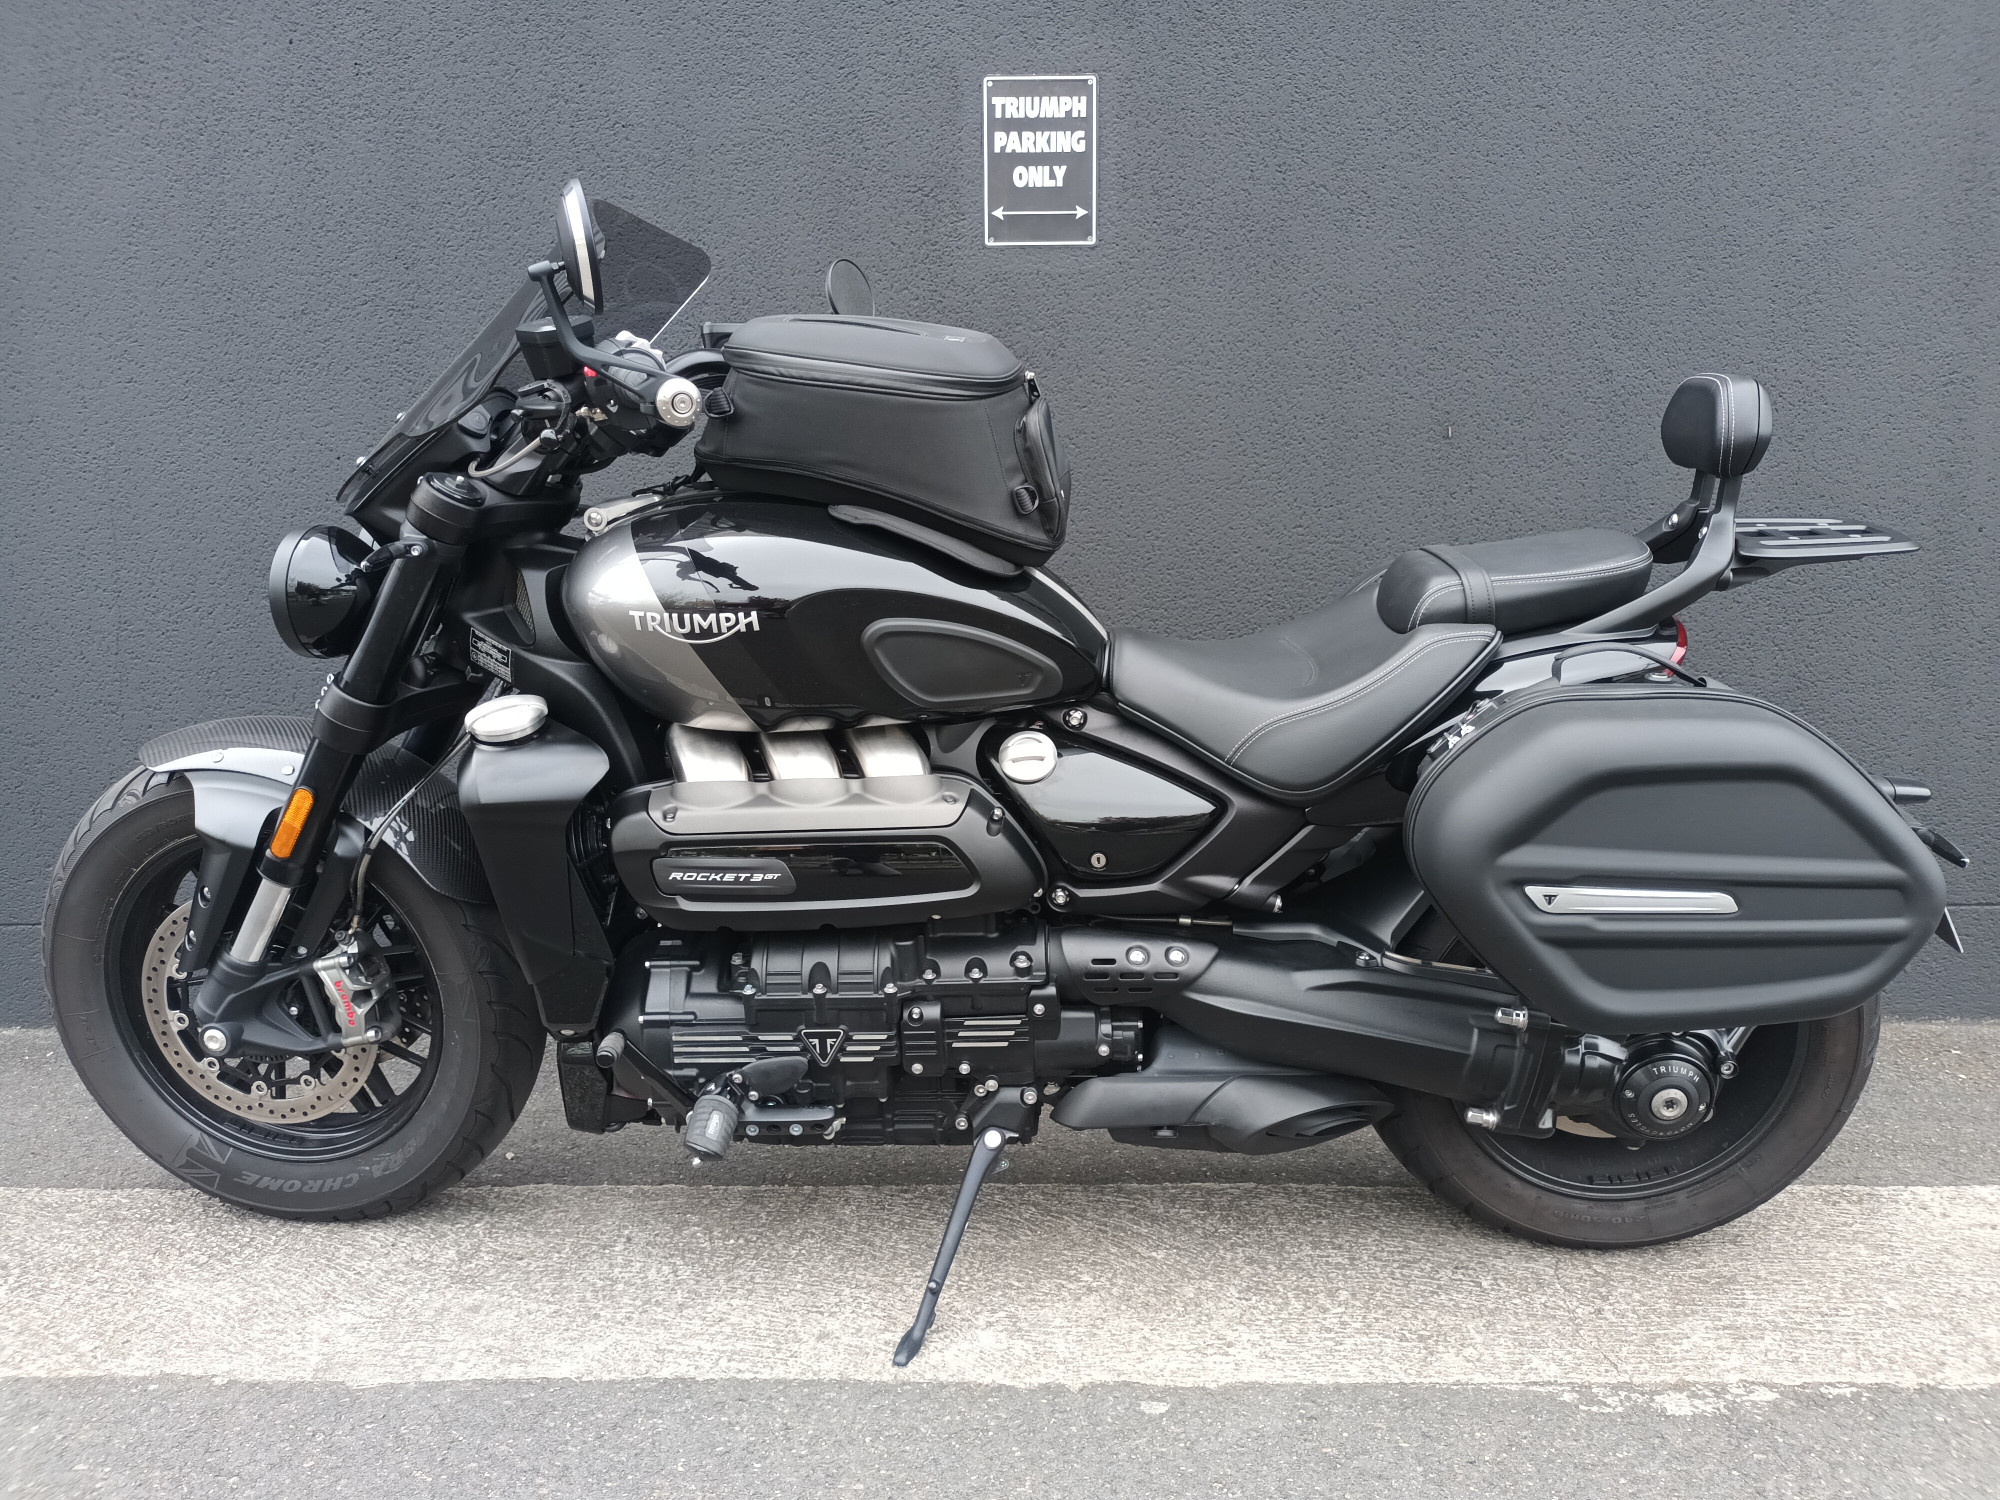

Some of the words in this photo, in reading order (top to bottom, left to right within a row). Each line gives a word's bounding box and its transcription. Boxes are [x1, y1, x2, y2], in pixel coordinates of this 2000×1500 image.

[992, 96, 1087, 118] TRIUMPH
[994, 131, 1086, 153] PARKING
[1013, 165, 1067, 188] ONLY
[629, 610, 760, 644] TRIUMPH
[334, 980, 356, 1027] brembo
[1652, 1065, 1700, 1083] TRIUMPH
[233, 1170, 360, 1193] CHROME
